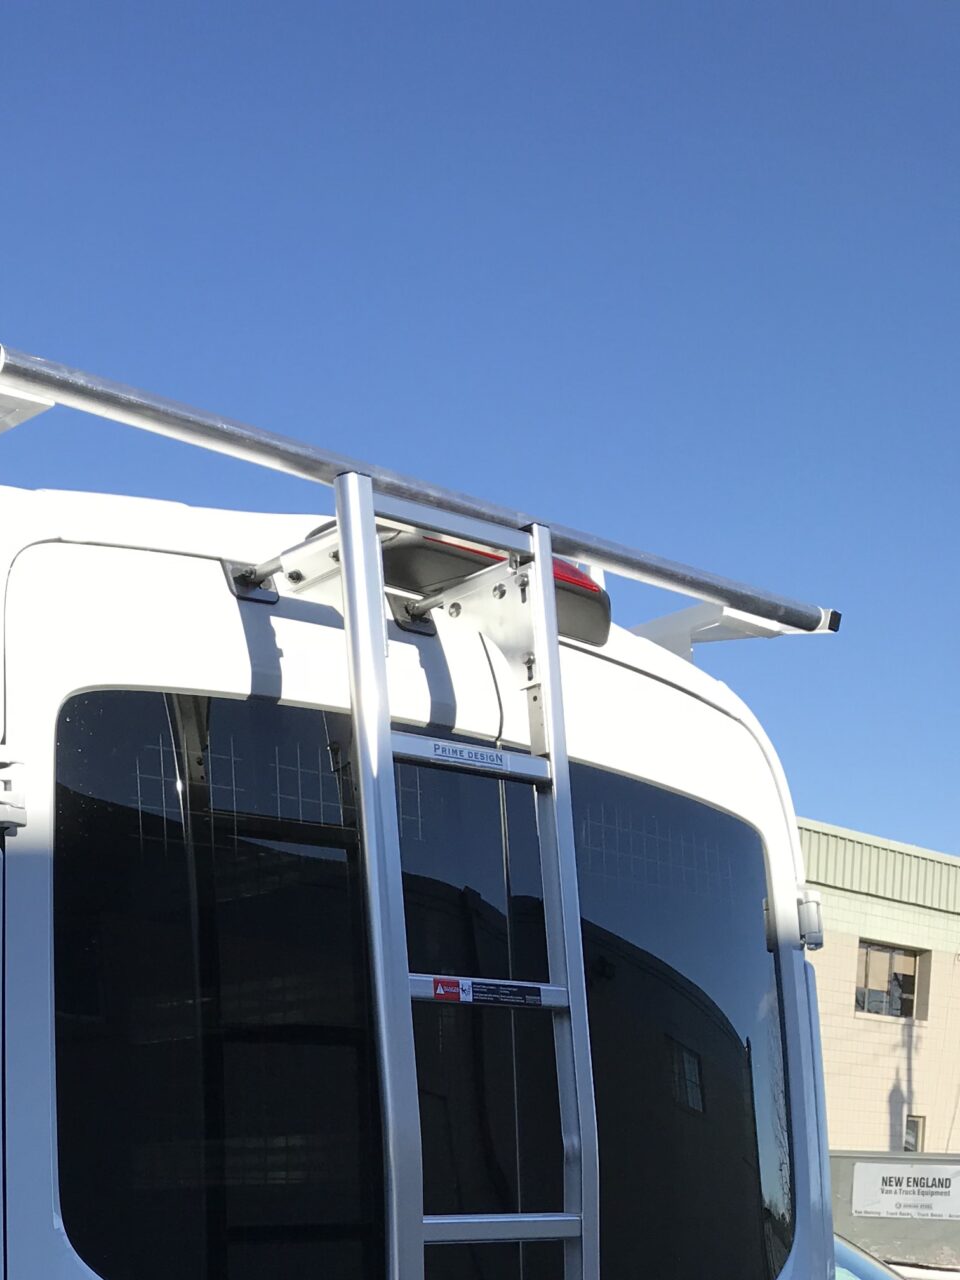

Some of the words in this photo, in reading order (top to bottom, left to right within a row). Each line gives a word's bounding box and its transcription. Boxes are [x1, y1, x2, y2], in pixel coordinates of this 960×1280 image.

[433, 743, 465, 758] PRIME
[467, 751, 503, 764] DESIGN
[881, 1176, 904, 1187] NEW
[906, 1177, 951, 1188] ENGLAND
[917, 1189, 951, 1197] Equipment
